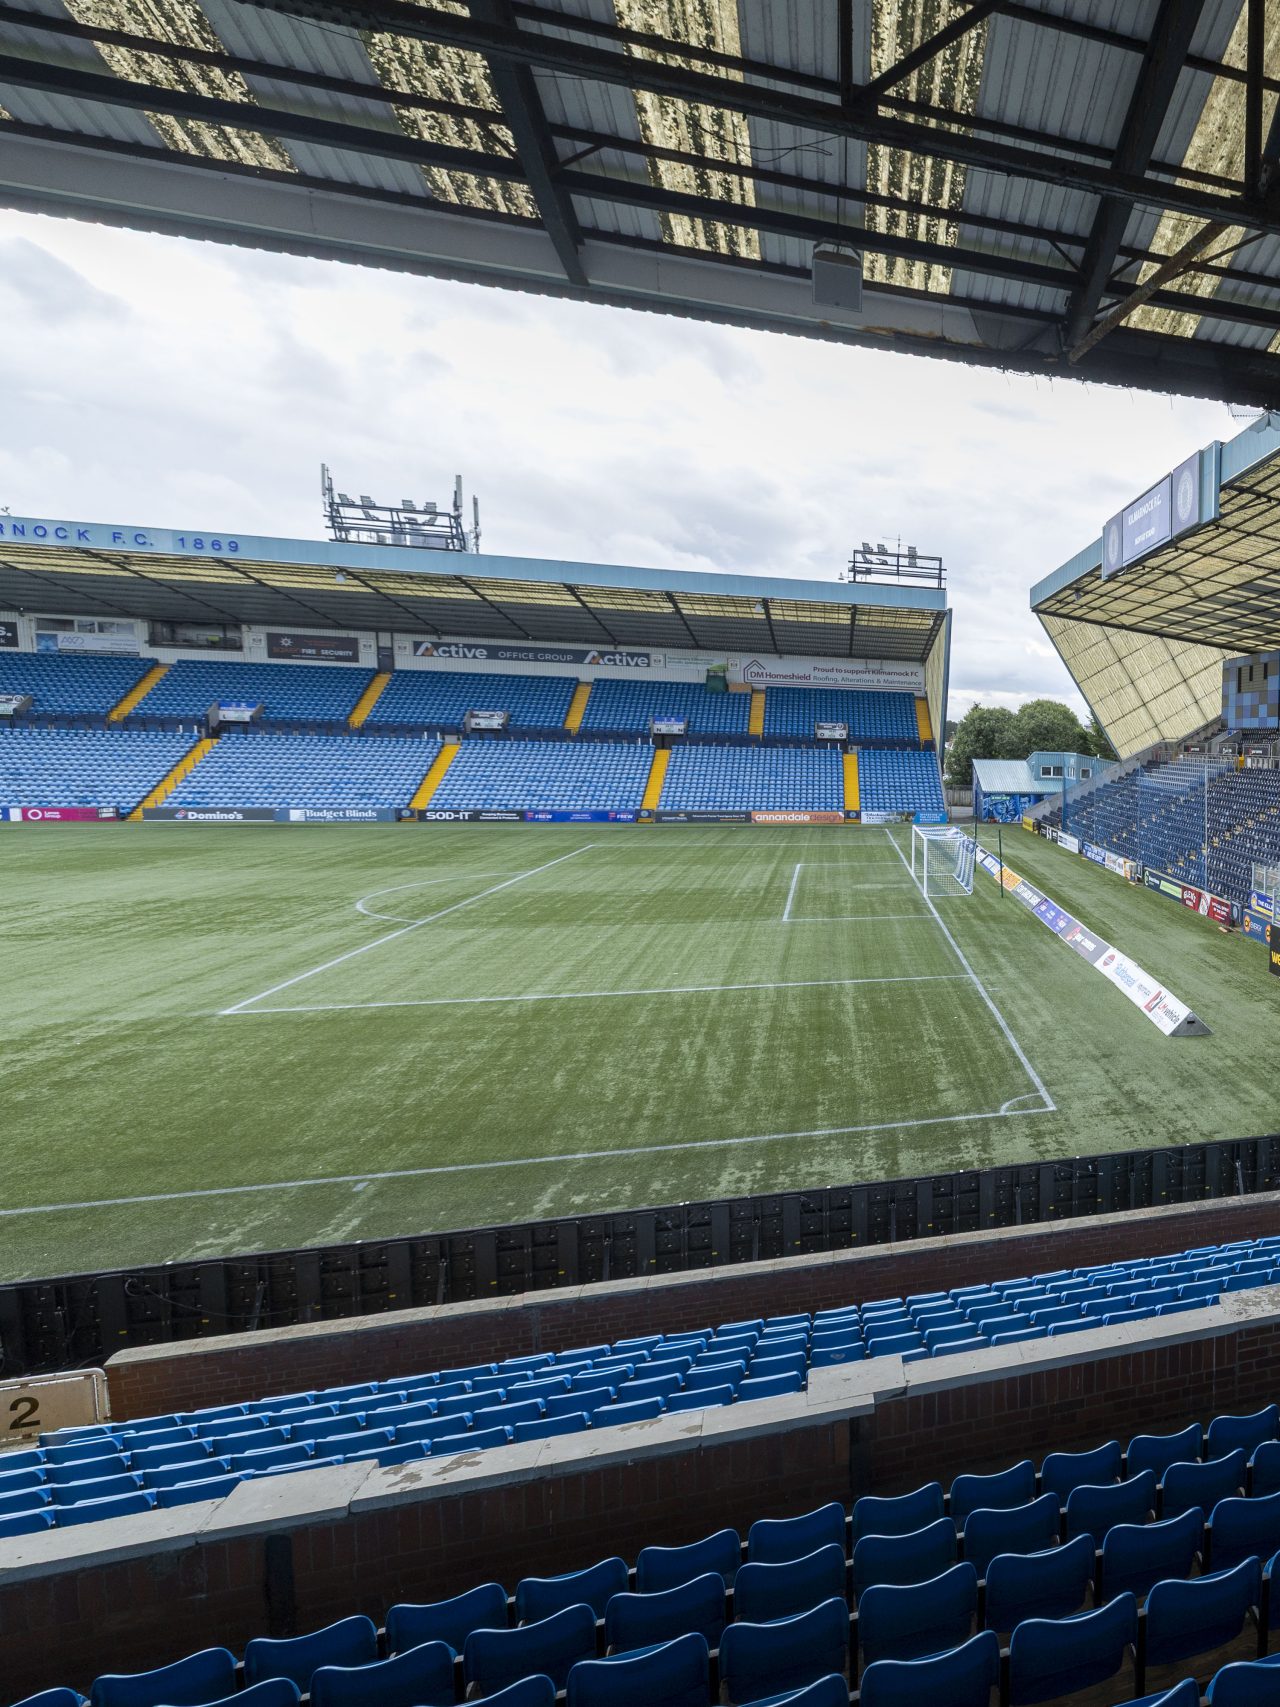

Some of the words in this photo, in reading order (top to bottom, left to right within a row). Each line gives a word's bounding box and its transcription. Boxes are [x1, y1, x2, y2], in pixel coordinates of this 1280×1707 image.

[178, 536, 239, 552] 1869
[415, 642, 488, 659] Active
[498, 651, 535, 660] OFFICE
[537, 652, 573, 662] GROUP
[583, 650, 649, 667] Active
[750, 671, 764, 679] DM
[765, 672, 811, 681] Homeshield
[188, 811, 243, 820] Domino's
[306, 809, 344, 818] Budget
[346, 809, 377, 817] Blinds
[9, 1396, 41, 1431] 2
